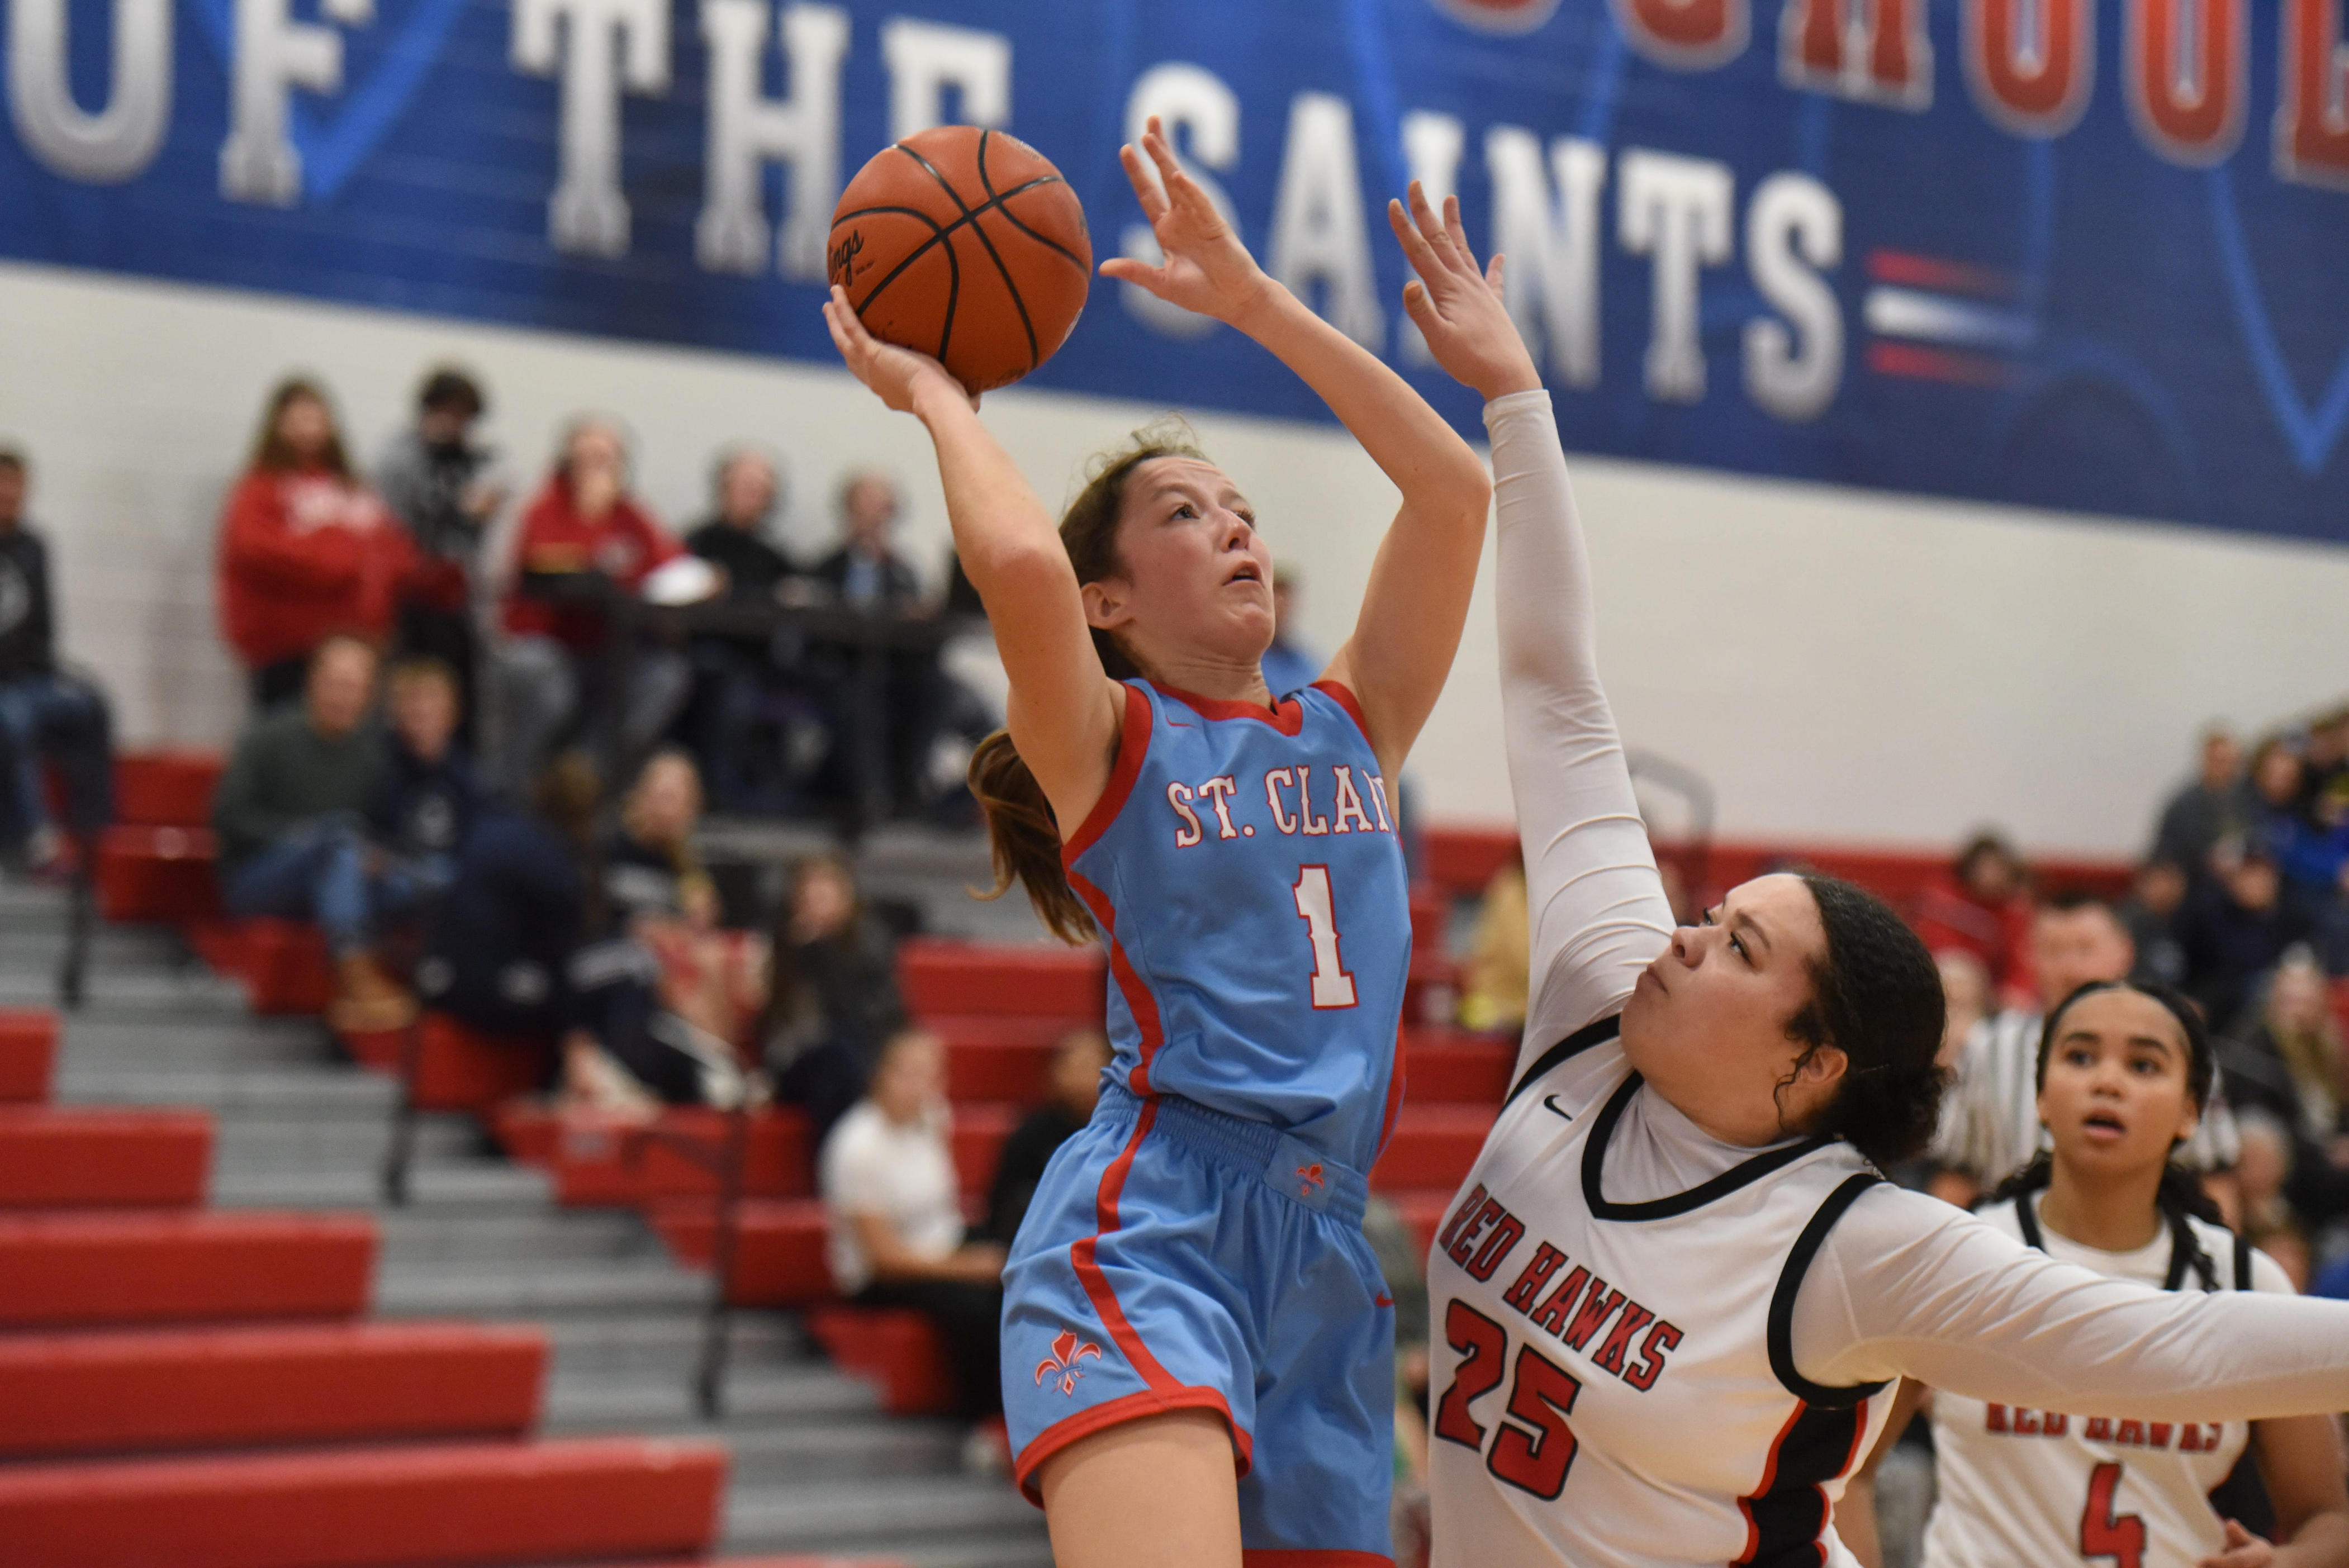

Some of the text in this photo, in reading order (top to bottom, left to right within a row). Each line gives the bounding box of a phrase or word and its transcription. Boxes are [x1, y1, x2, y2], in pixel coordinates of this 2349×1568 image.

[1122, 61, 1845, 420] SAINTS
[1167, 775, 1255, 848] ST.
[1292, 864, 1359, 1010] 1
[1438, 1182, 1685, 1392] RED HAWKS
[1435, 1298, 1582, 1502] 25
[2080, 1461, 2146, 1568] 4
